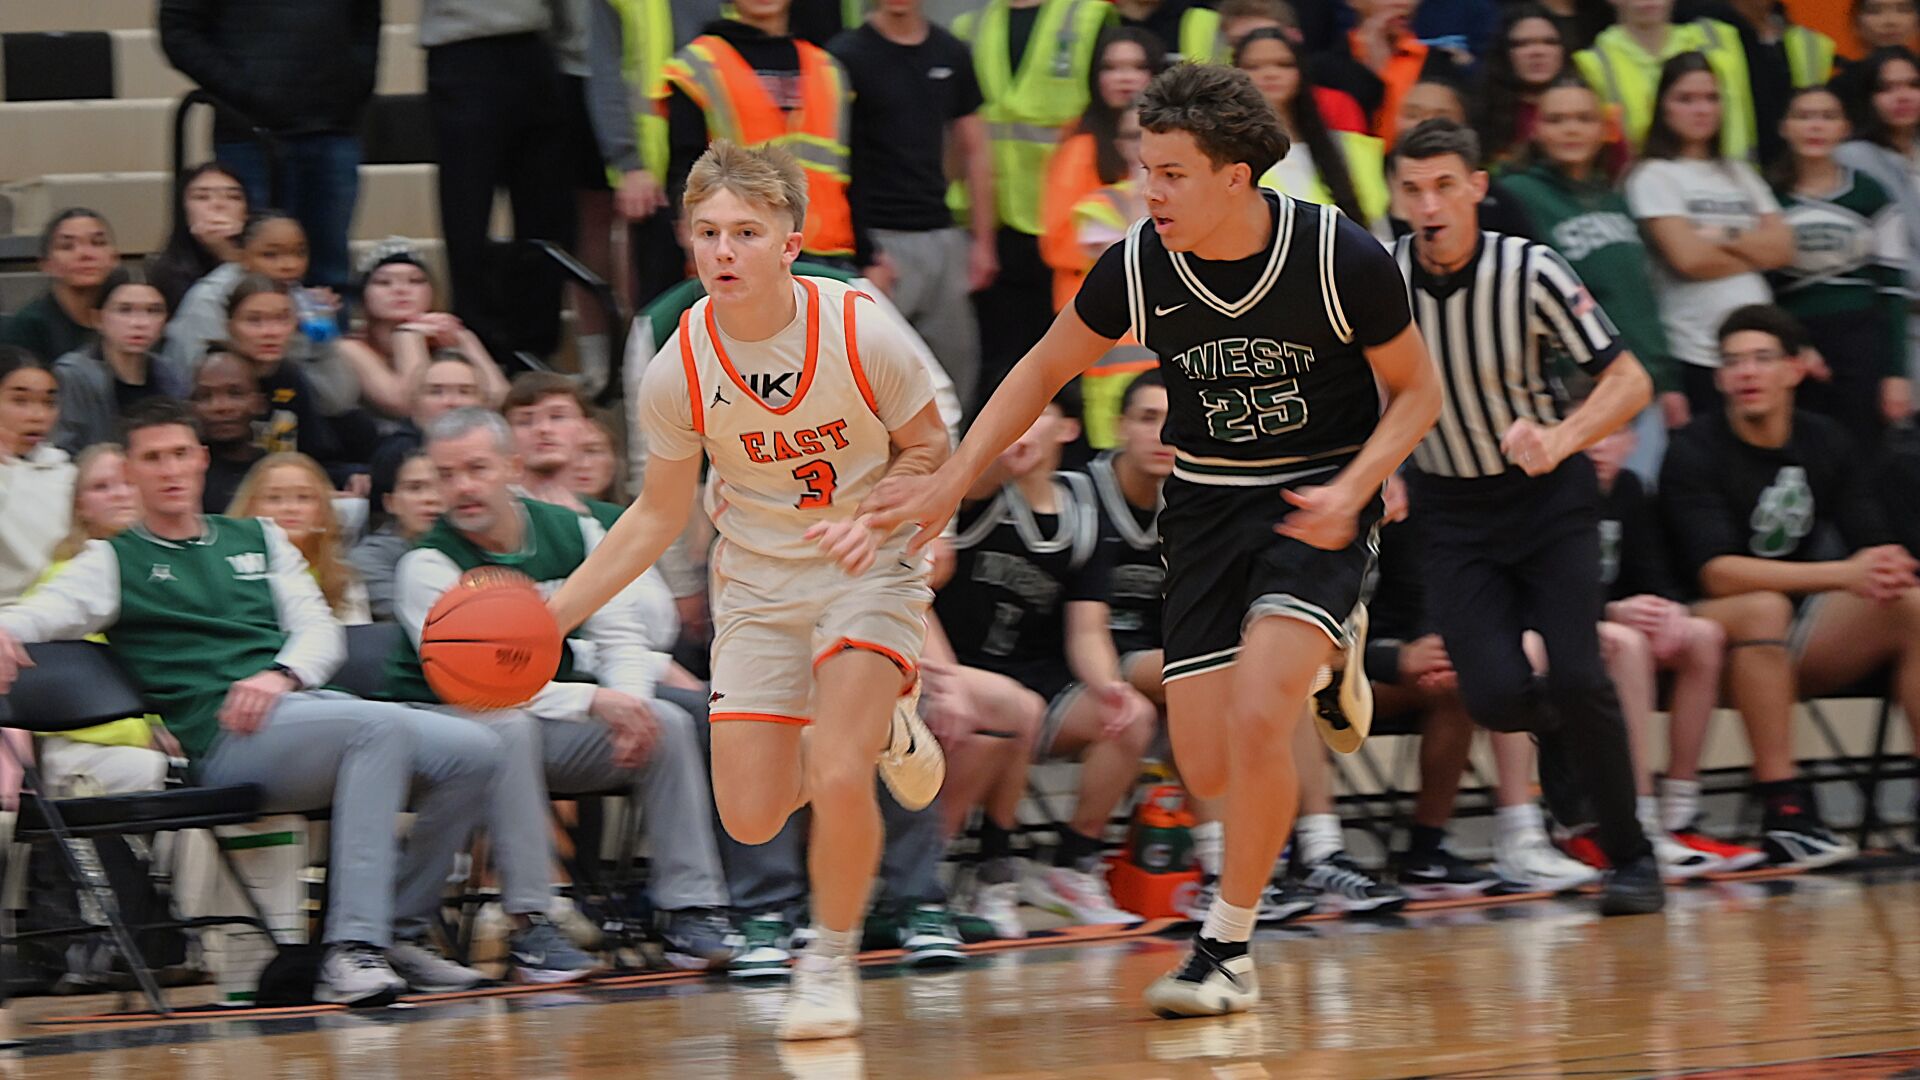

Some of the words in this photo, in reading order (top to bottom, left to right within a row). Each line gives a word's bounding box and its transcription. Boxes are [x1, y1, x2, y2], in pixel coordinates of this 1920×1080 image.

[1171, 337, 1316, 380] WEST
[741, 371, 803, 399] IK
[1198, 377, 1308, 442] 25
[739, 418, 850, 464] EAST
[791, 458, 837, 509] 3
